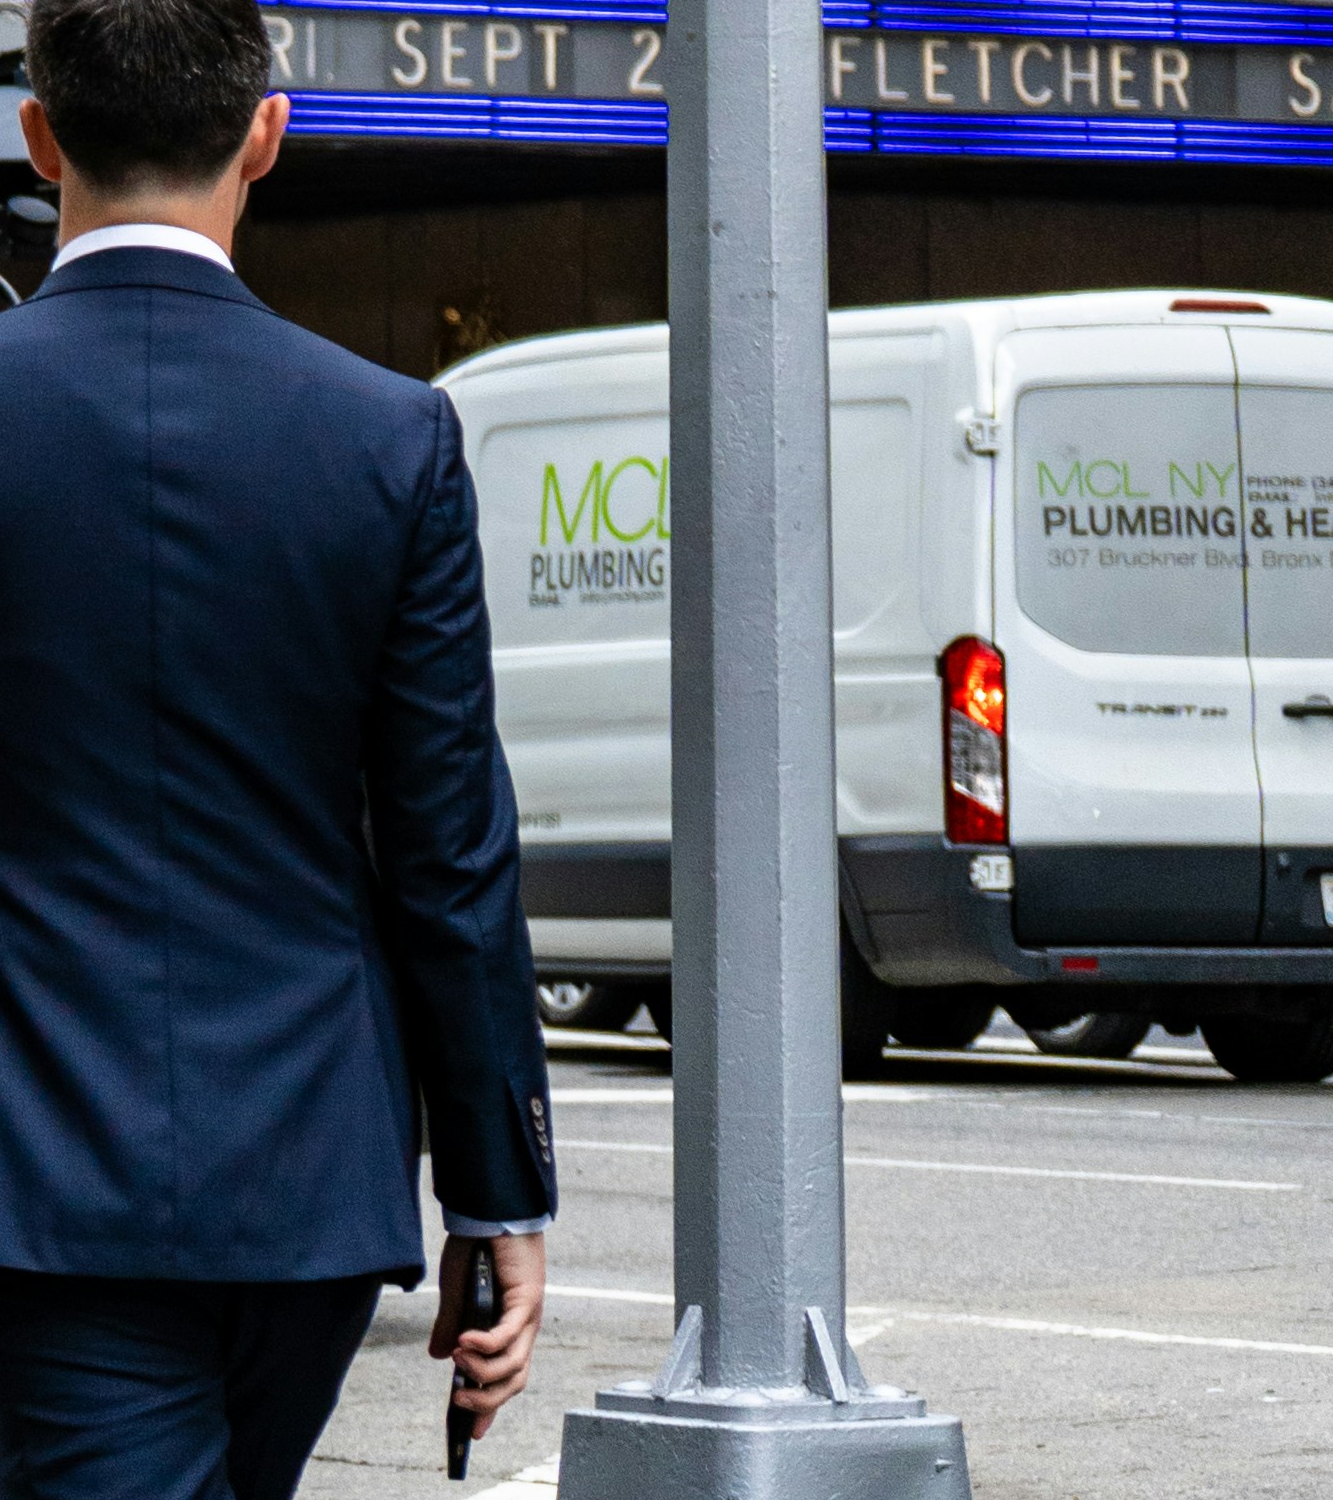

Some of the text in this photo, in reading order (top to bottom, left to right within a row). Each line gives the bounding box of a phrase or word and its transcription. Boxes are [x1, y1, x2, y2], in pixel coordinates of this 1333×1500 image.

[391, 18, 569, 91] SEPT
[831, 35, 1192, 112] FLETCHER
[1288, 52, 1333, 117] S
[1036, 458, 1237, 499] MCL NY
[540, 455, 671, 546] MCL
[1043, 505, 1333, 538] PLUMBING & HE
[530, 547, 665, 592] PLUMBING
[1047, 548, 1089, 568] 307
[1098, 547, 1196, 568] Bruckner
[1262, 549, 1323, 569] Bronx
